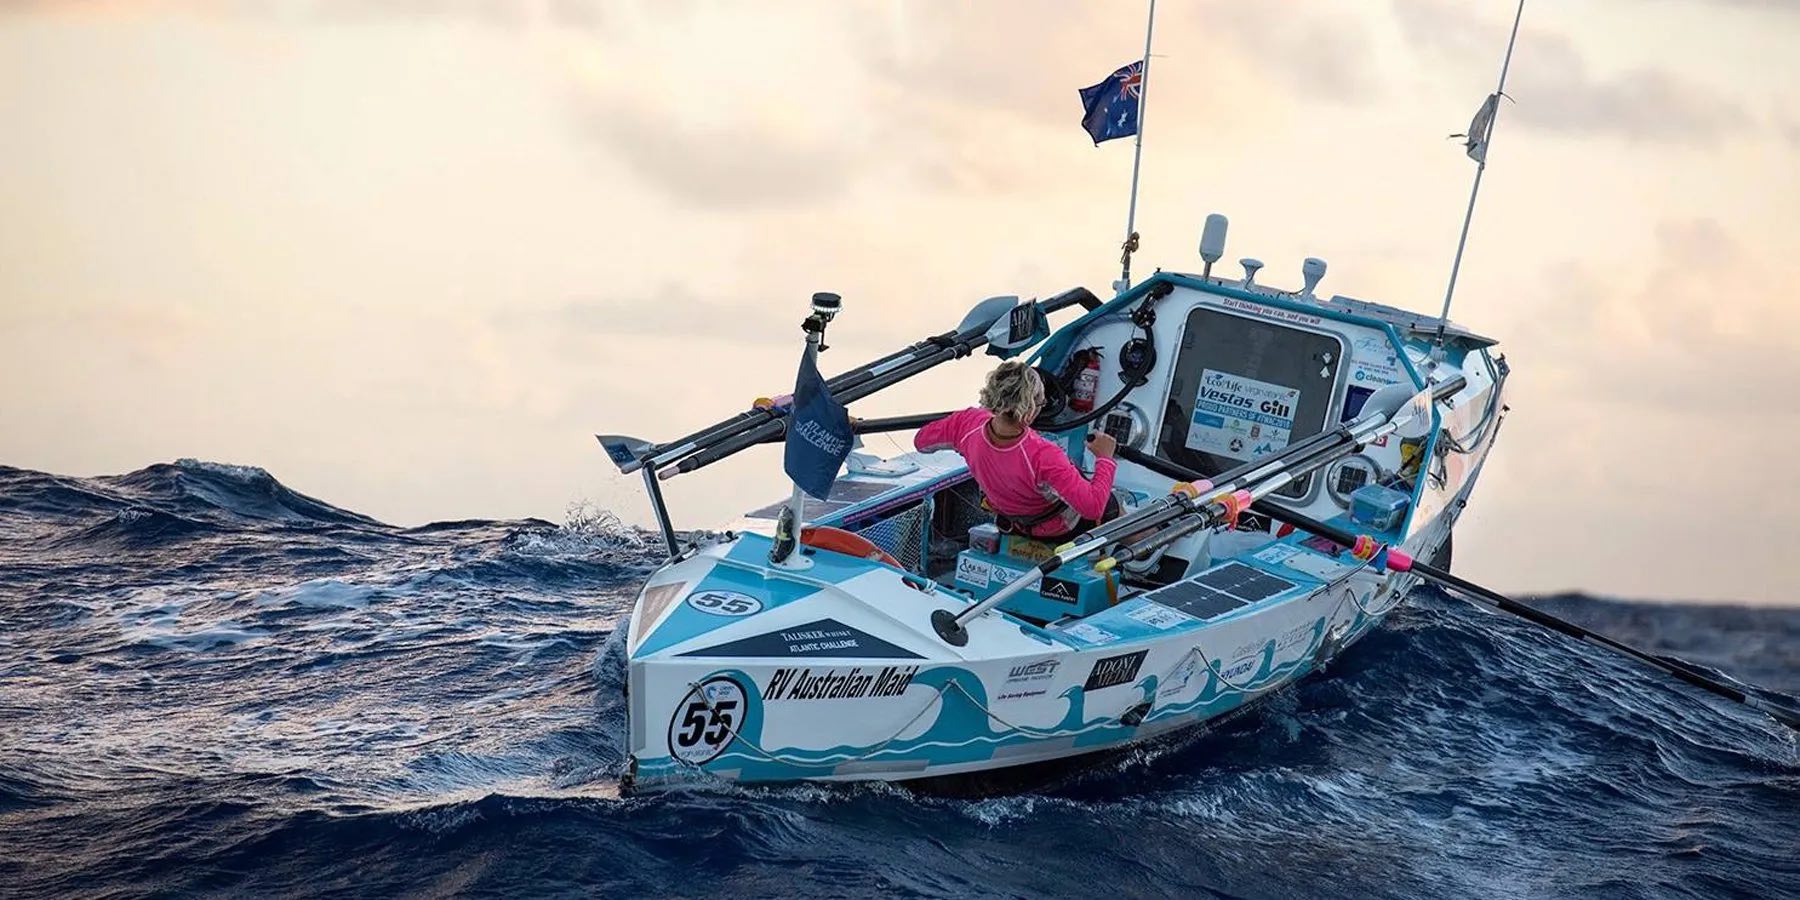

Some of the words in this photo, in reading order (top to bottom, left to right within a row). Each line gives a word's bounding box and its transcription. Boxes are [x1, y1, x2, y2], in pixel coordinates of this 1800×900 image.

[1201, 386, 1254, 408] Vestas
[1261, 400, 1290, 417] Gill
[795, 421, 841, 456] CHALLENGE
[803, 420, 845, 448] ATLANTIC
[695, 593, 753, 613] 55
[781, 630, 825, 641] TALISKER
[790, 643, 820, 653] ATLANTIC
[820, 639, 859, 650] CHALLENGE
[761, 668, 797, 700] RV
[787, 668, 873, 700] Australian
[868, 665, 919, 697] Maid
[1009, 660, 1061, 677] WEST
[678, 700, 738, 747] 55
